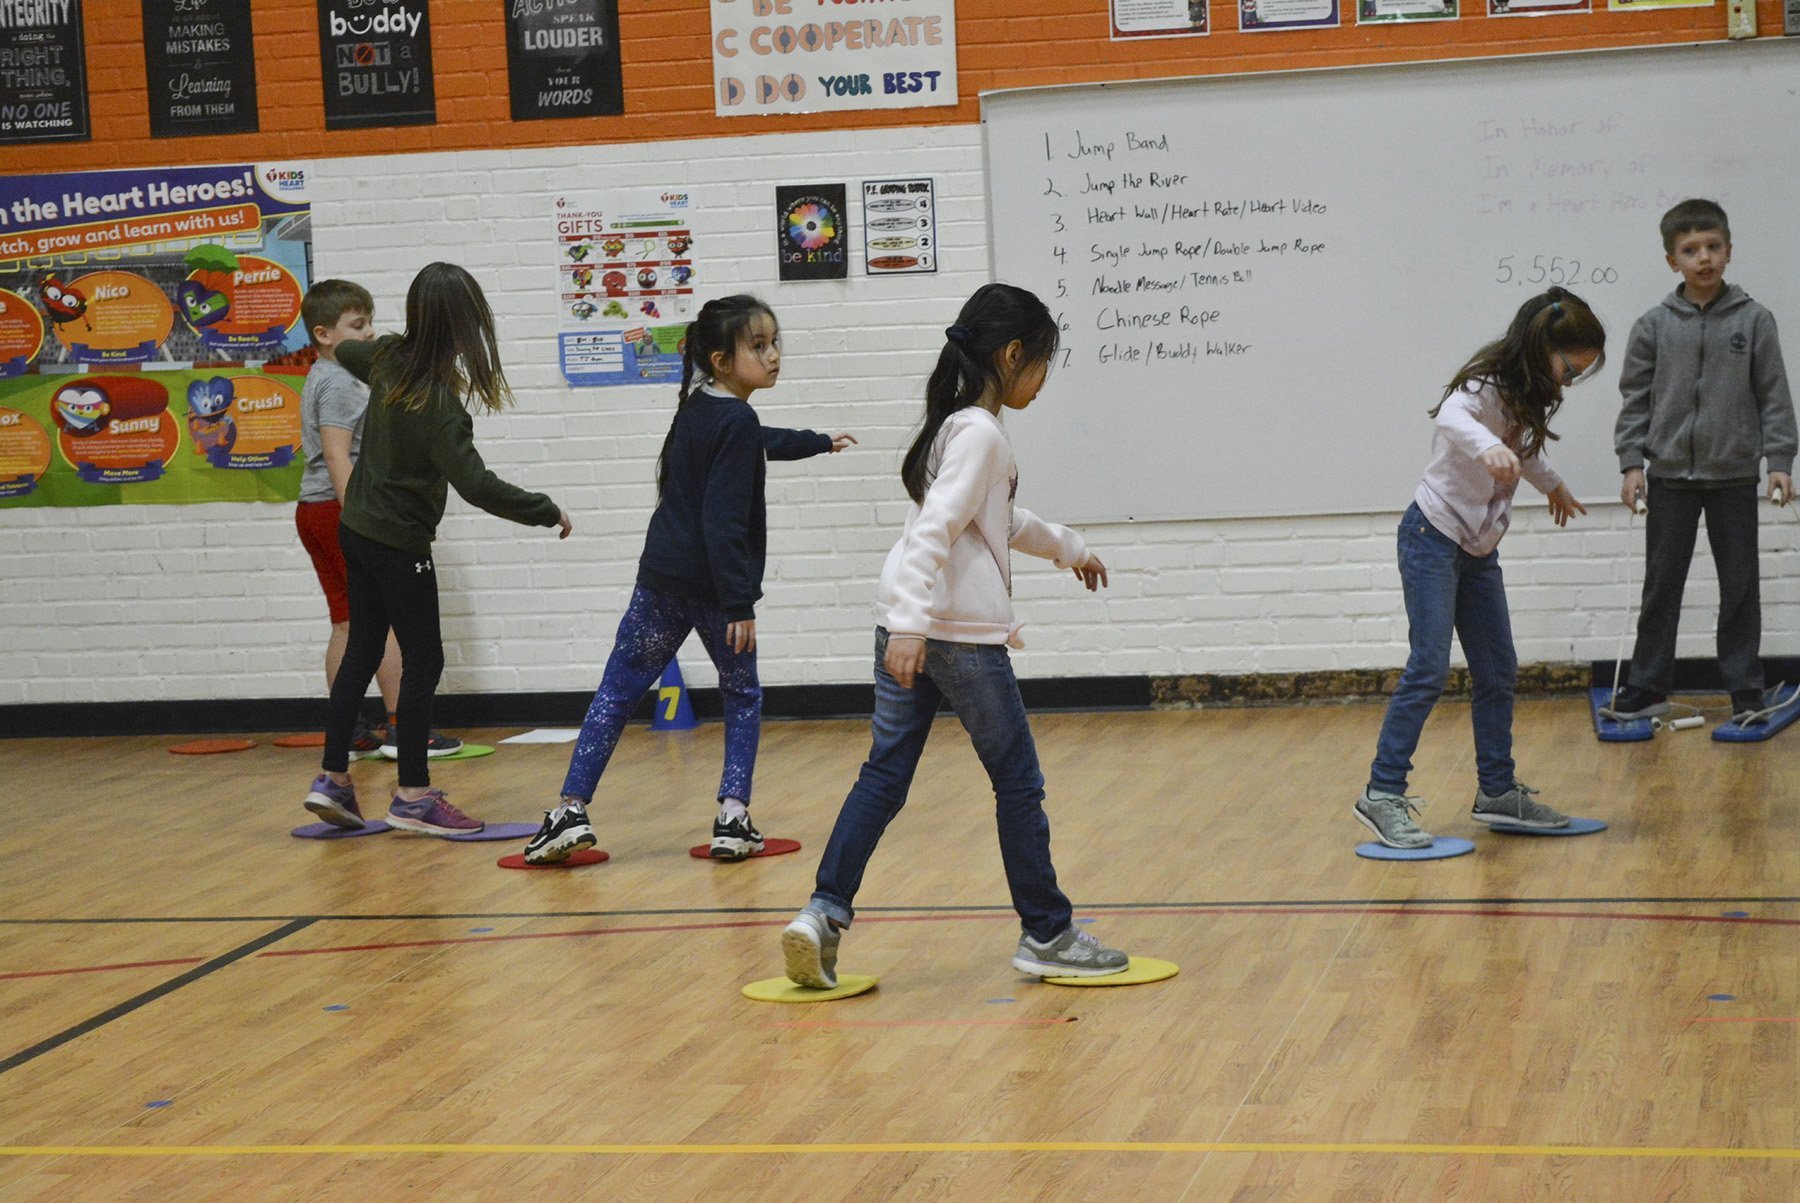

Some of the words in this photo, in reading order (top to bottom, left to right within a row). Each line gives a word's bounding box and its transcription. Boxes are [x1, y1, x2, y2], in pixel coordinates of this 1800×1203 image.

[168, 23, 225, 38] MAKING
[330, 6, 422, 37] buddy
[166, 38, 230, 54] MISTAKES
[524, 26, 603, 50] LOUDER
[716, 28, 739, 58] C
[750, 15, 943, 55] COOPERATE
[0, 46, 63, 66] RIGHT
[1, 67, 71, 88] THING,
[169, 72, 231, 99] Learning
[338, 67, 420, 96] BULLY!
[538, 88, 593, 107] WORDS
[720, 77, 745, 106] D
[755, 73, 806, 104] DO
[818, 73, 872, 97] YOUR
[883, 71, 941, 94] BEST
[2, 104, 28, 120] NO
[34, 101, 71, 118] ONE
[170, 106, 201, 118] FROM
[204, 103, 235, 115] THEM
[1, 122, 11, 130] IS
[14, 118, 73, 129] WATCHING
[1477, 119, 1509, 142] In
[1067, 130, 1115, 161] Jump
[1126, 131, 1169, 153] Band
[279, 171, 304, 180] KIDS
[1080, 173, 1116, 195] Jump
[1122, 173, 1143, 189] the
[1150, 172, 1188, 188] River
[11, 197, 58, 223] the
[62, 186, 144, 217] Heart
[147, 171, 254, 207] Heroes!
[669, 193, 689, 201] KIDS
[920, 200, 927, 208] 4
[1087, 206, 1127, 224] Heart
[1292, 199, 1328, 215] Video
[37, 234, 81, 253] grow
[85, 225, 121, 243] and
[123, 222, 172, 238] learn
[174, 213, 215, 232] with
[218, 209, 245, 226] us!
[557, 219, 603, 234] GIFTS
[920, 219, 928, 227] 3
[921, 238, 929, 246] 2
[782, 249, 802, 263] be
[807, 247, 843, 263] kind
[922, 257, 928, 265] 1
[1090, 243, 1130, 267] Single
[1138, 244, 1168, 259] Jump
[1259, 239, 1287, 254] Jump
[1293, 238, 1326, 254] Rope
[234, 267, 281, 286] Perrie
[1091, 275, 1131, 296] Noodle
[95, 285, 129, 300] Nico
[1097, 307, 1171, 330] Chinese
[1180, 305, 1221, 329] Rope
[1206, 340, 1253, 357] Walker
[237, 393, 284, 411] Crush
[110, 417, 160, 434] Sunny
[659, 686, 681, 721] 7
